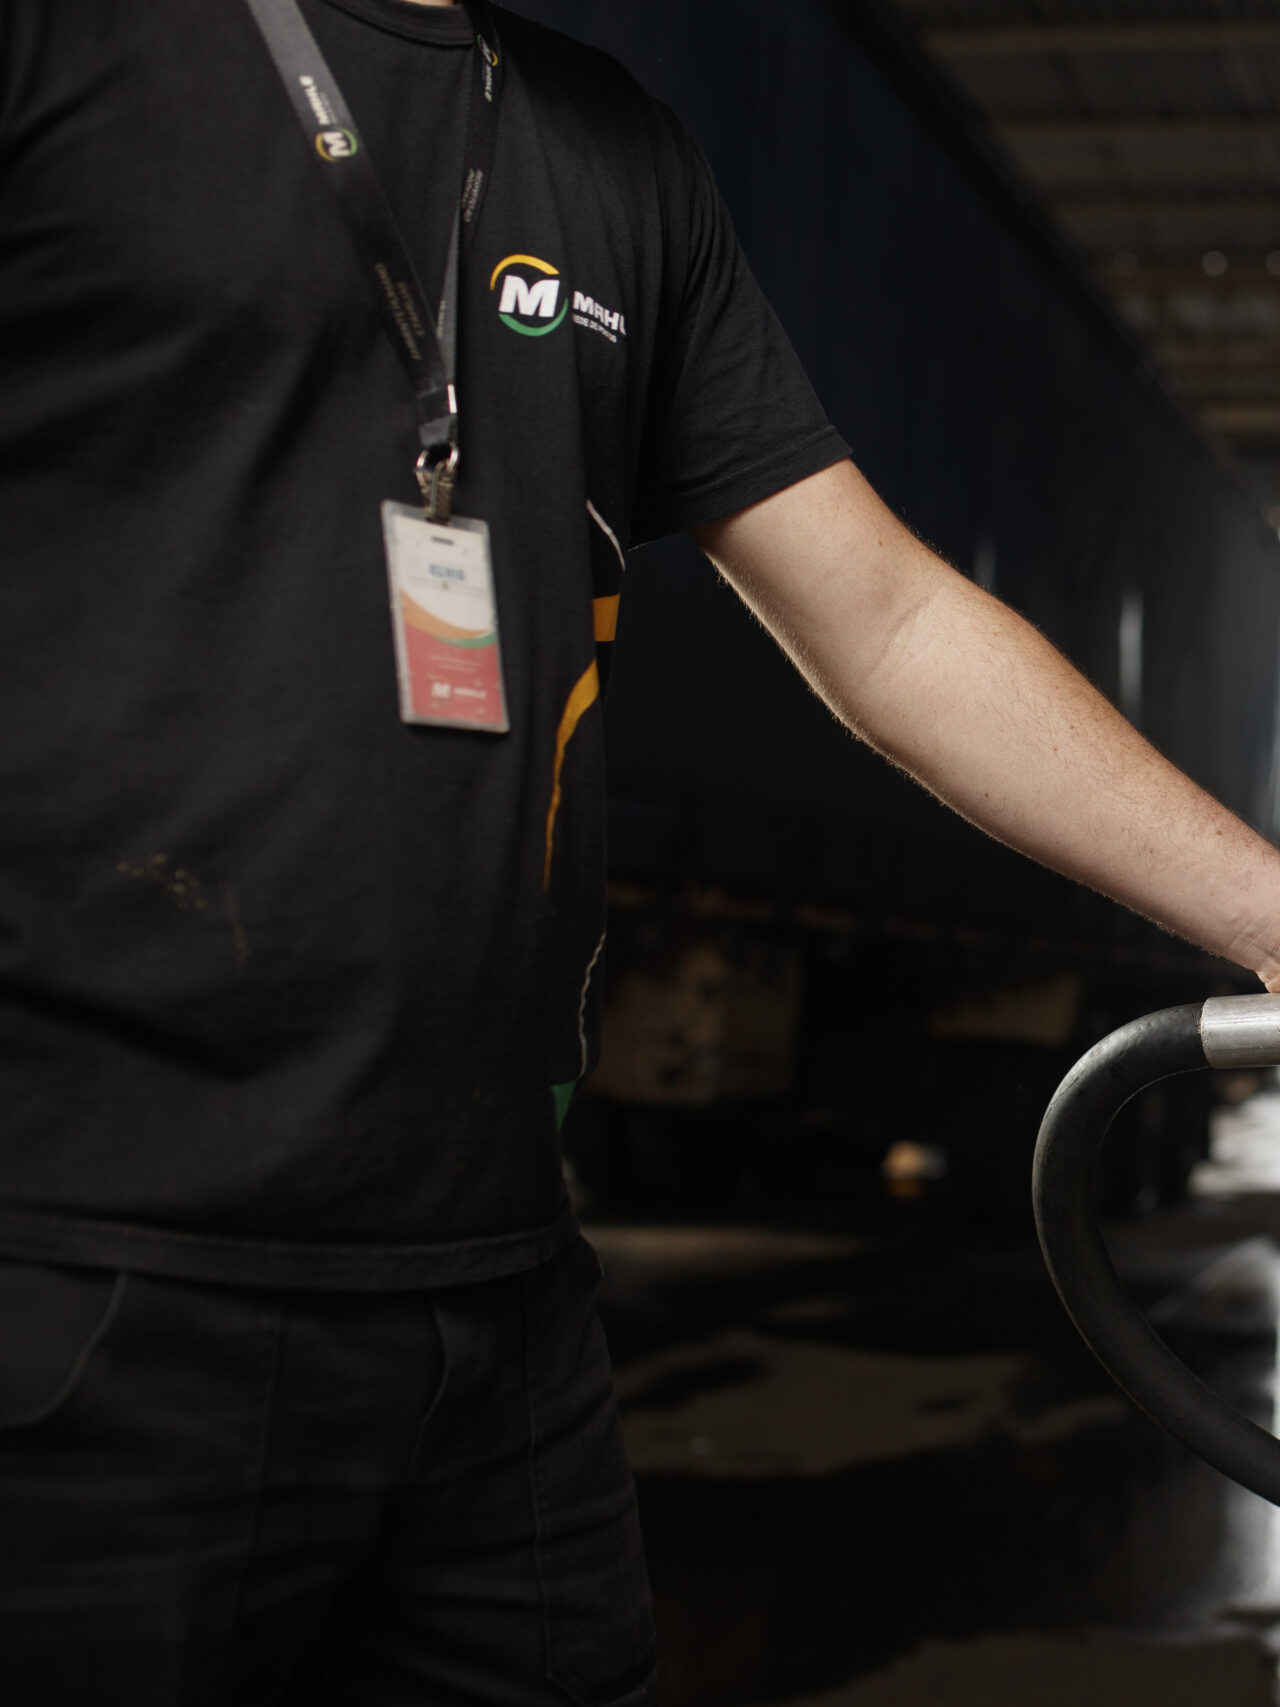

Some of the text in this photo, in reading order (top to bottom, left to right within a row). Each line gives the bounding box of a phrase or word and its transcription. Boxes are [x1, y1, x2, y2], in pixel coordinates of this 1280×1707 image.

[322, 131, 351, 157] M
[498, 274, 560, 318] M
[572, 290, 627, 336] MAHL
